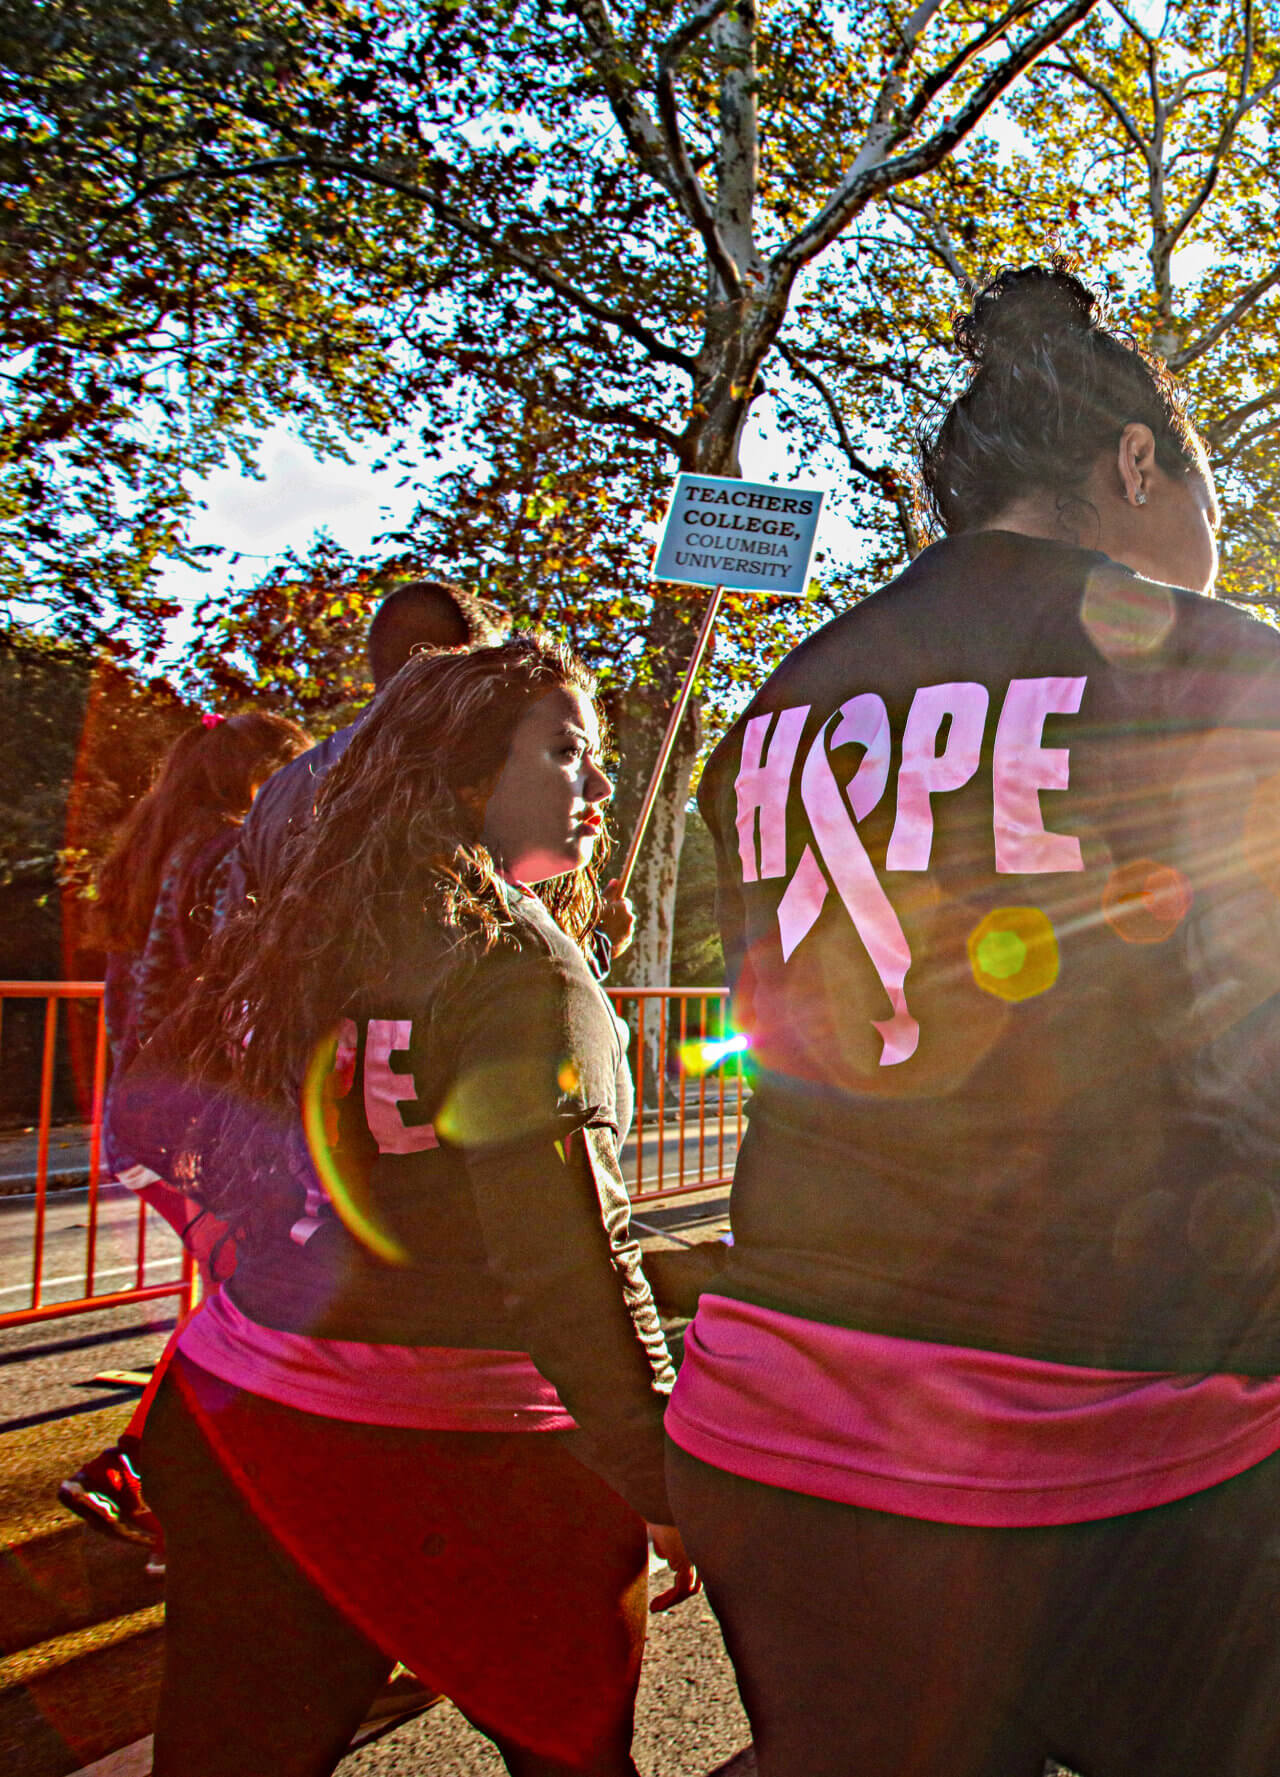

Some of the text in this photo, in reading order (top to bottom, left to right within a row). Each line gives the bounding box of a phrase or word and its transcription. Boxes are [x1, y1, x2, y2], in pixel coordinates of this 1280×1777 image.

[685, 486, 814, 515] TEACHERS
[683, 510, 801, 541] COLLEGE,
[686, 533, 789, 557] COLUMBIA
[675, 551, 792, 577] UNIVERSITY
[735, 676, 1088, 883] HOPE
